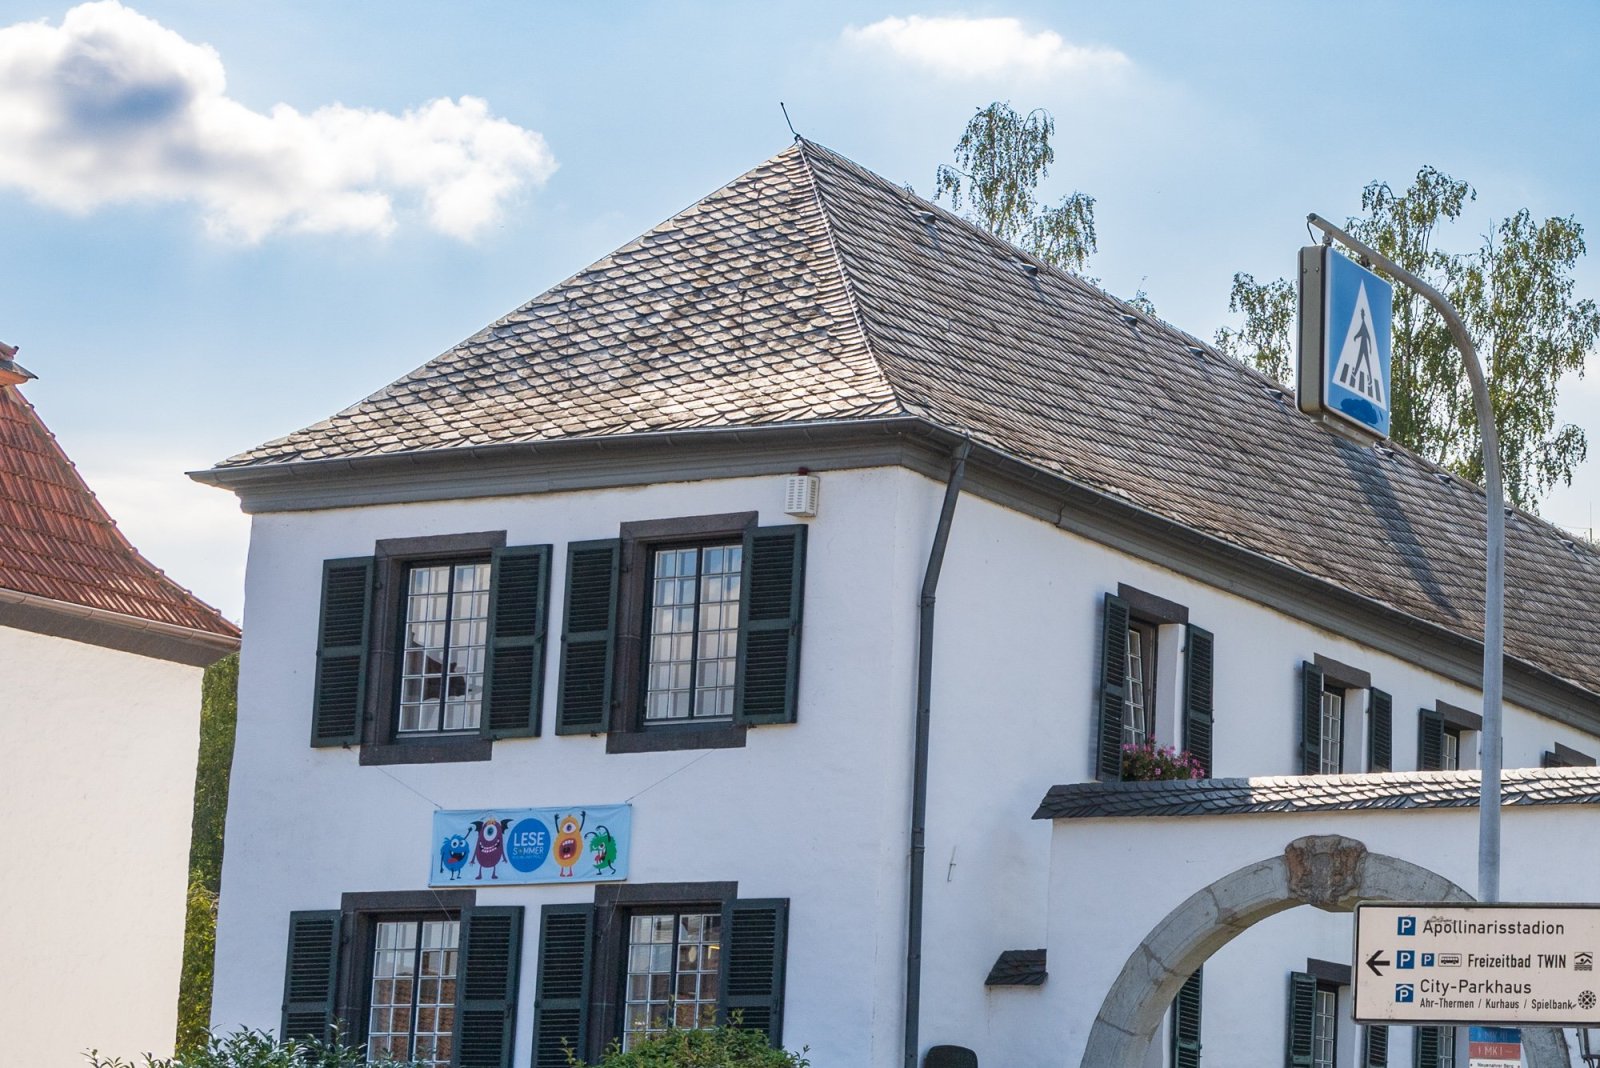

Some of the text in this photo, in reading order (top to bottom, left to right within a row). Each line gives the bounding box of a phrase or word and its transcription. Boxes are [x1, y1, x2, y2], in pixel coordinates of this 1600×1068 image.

[513, 831, 545, 847] LESE
[1422, 920, 1564, 937] Apollinarisstadion
[1467, 953, 1531, 969] Freizeitbad
[1537, 954, 1567, 969] TWIN
[1420, 979, 1532, 996] City-Parkhaus
[1419, 998, 1475, 1009] Ahr-Thermen
[1485, 999, 1520, 1010] Kurhaus
[1531, 999, 1573, 1011] Spielbank
